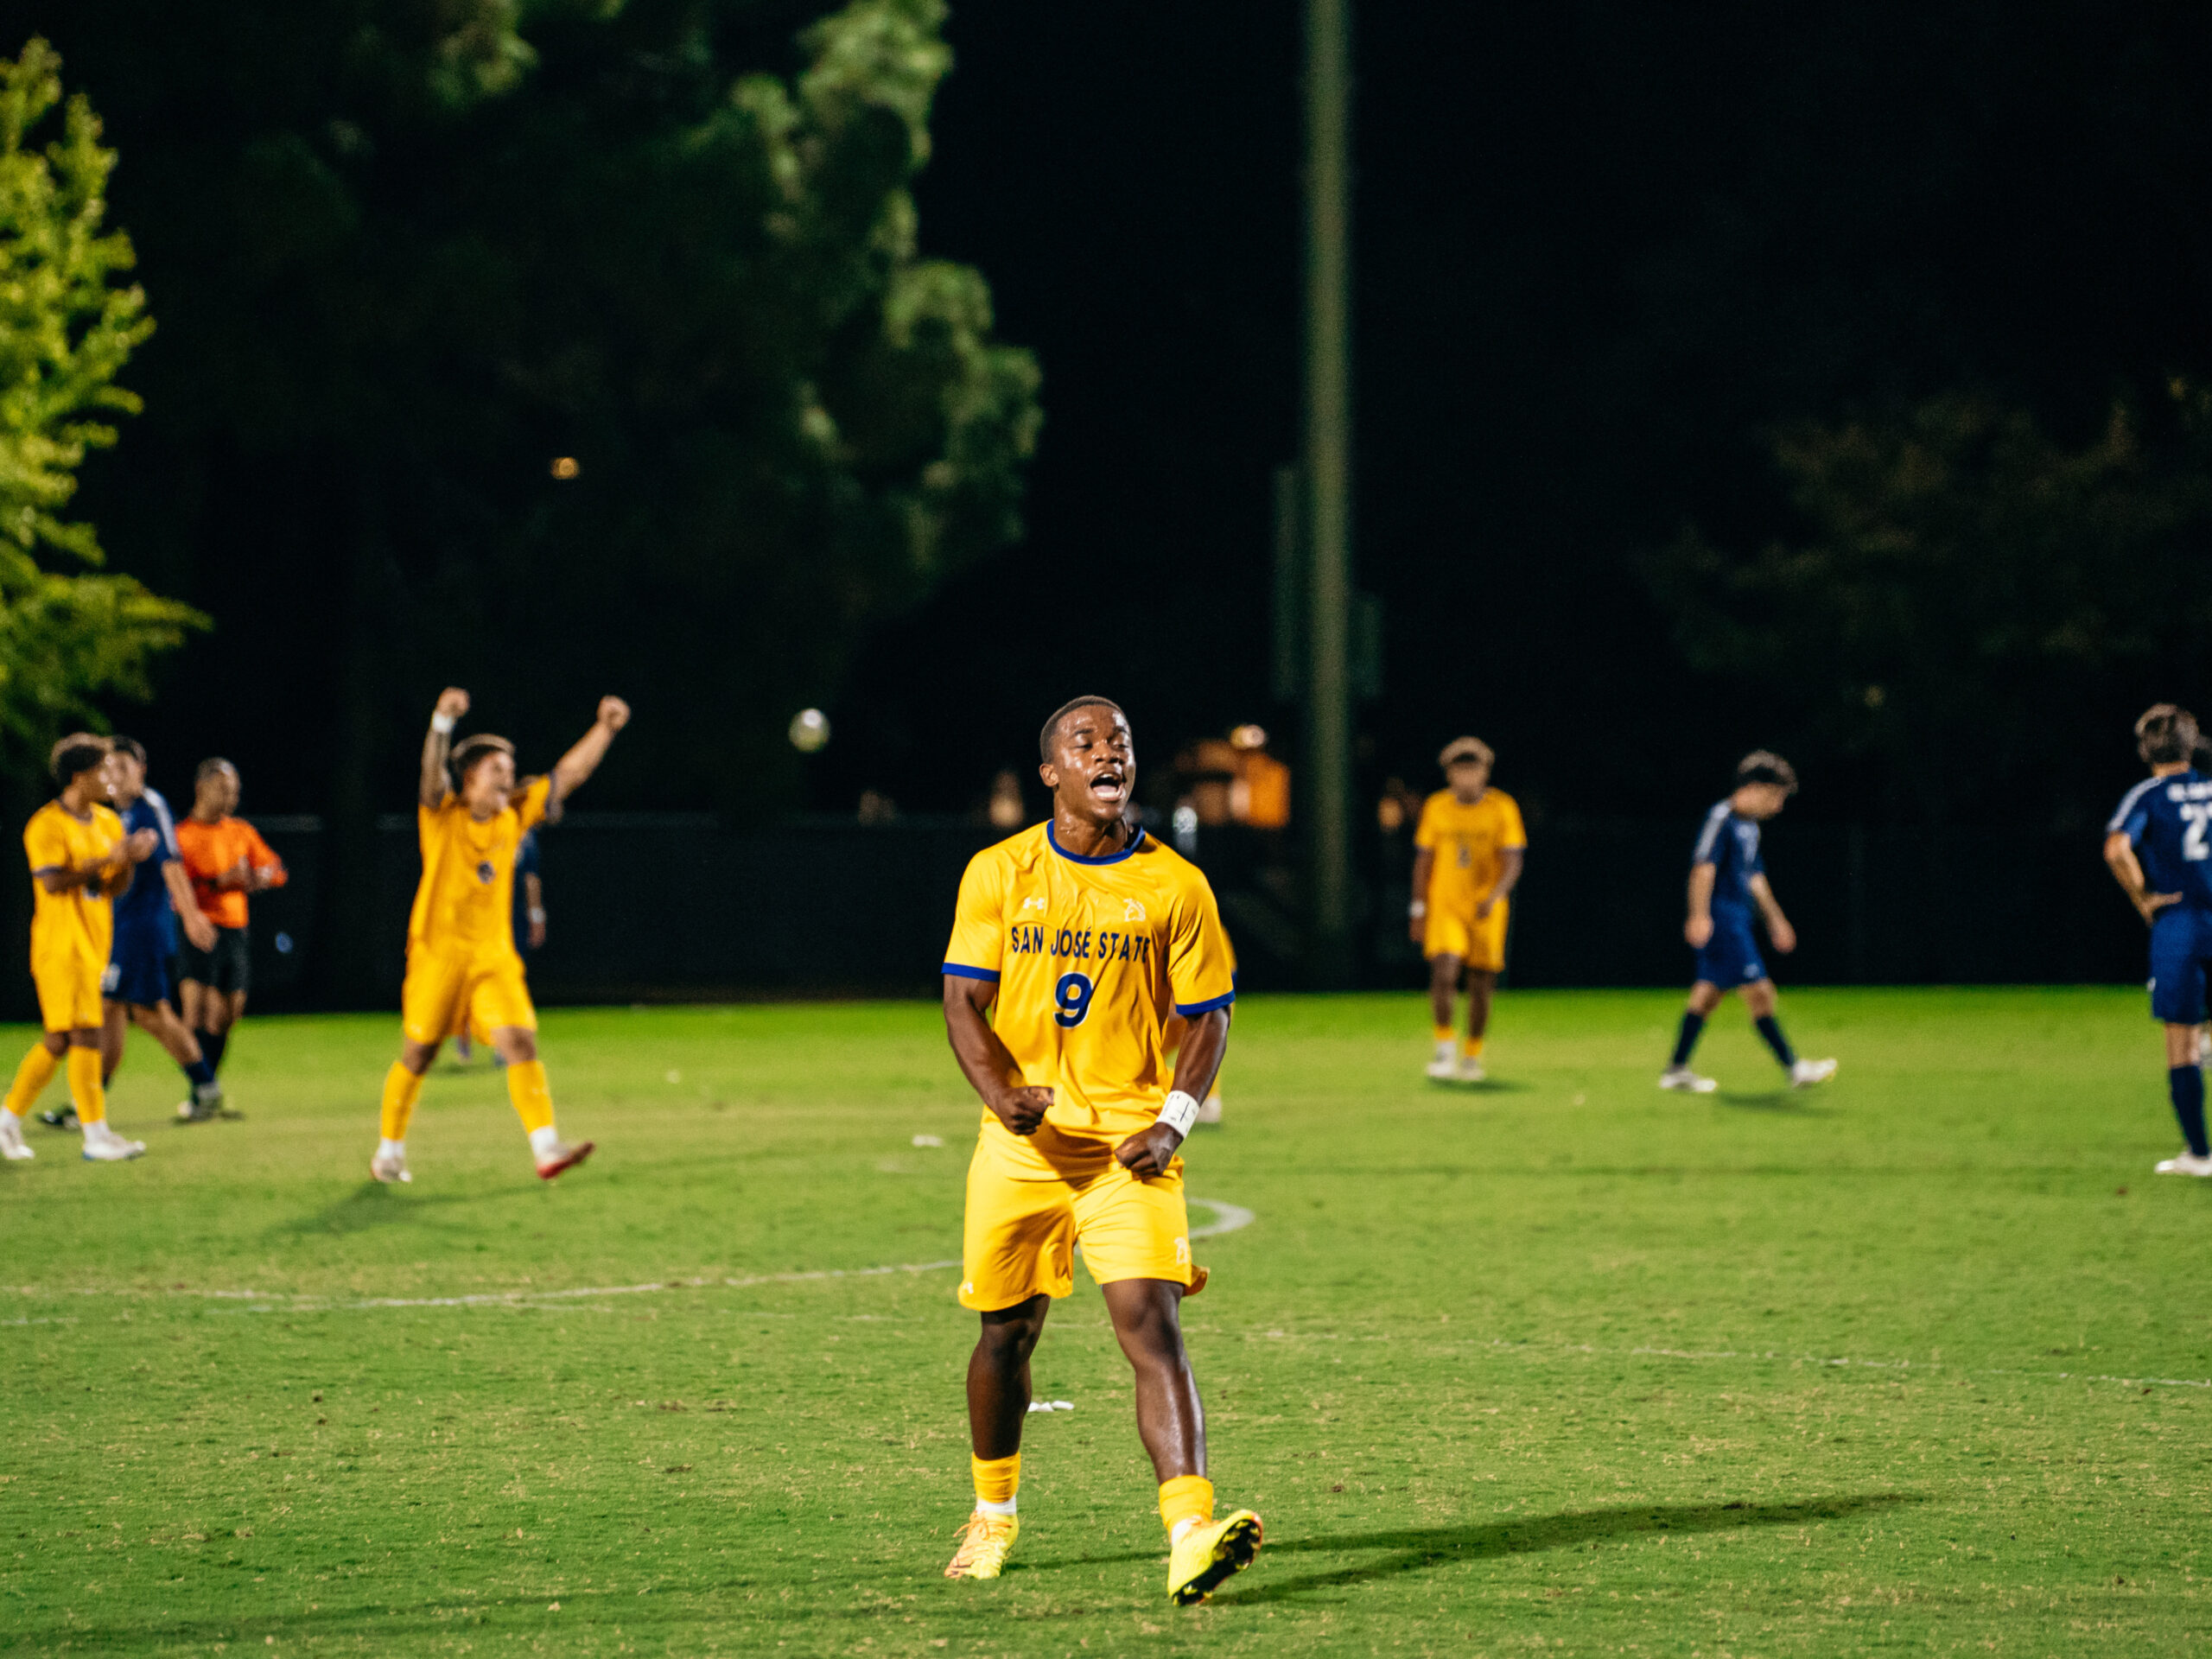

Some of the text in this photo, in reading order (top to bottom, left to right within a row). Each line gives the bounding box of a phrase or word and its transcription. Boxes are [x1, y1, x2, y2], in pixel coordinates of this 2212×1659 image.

[1011, 925, 1150, 963] SAN JOSÉ STATE
[1054, 972, 1093, 1027] 9
